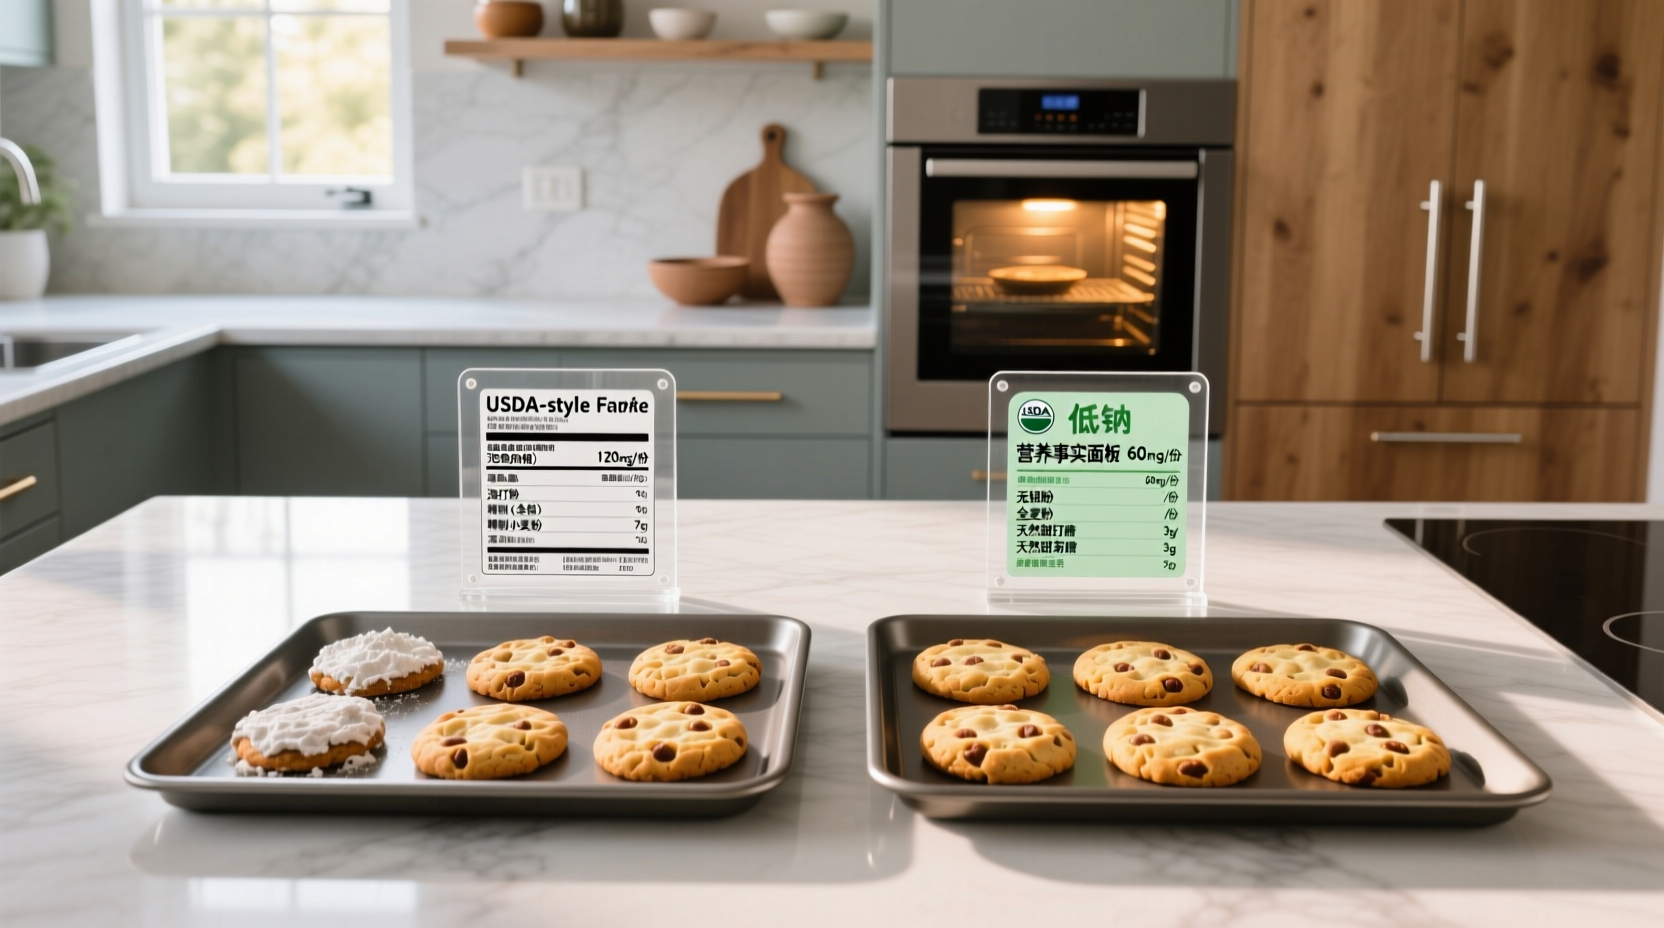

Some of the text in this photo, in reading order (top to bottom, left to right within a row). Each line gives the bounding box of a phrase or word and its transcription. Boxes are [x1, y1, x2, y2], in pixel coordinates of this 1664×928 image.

[486, 395, 590, 418] USDA-style
[1068, 403, 1132, 434] 低钠
[1016, 442, 1121, 464] 营养事实面板
